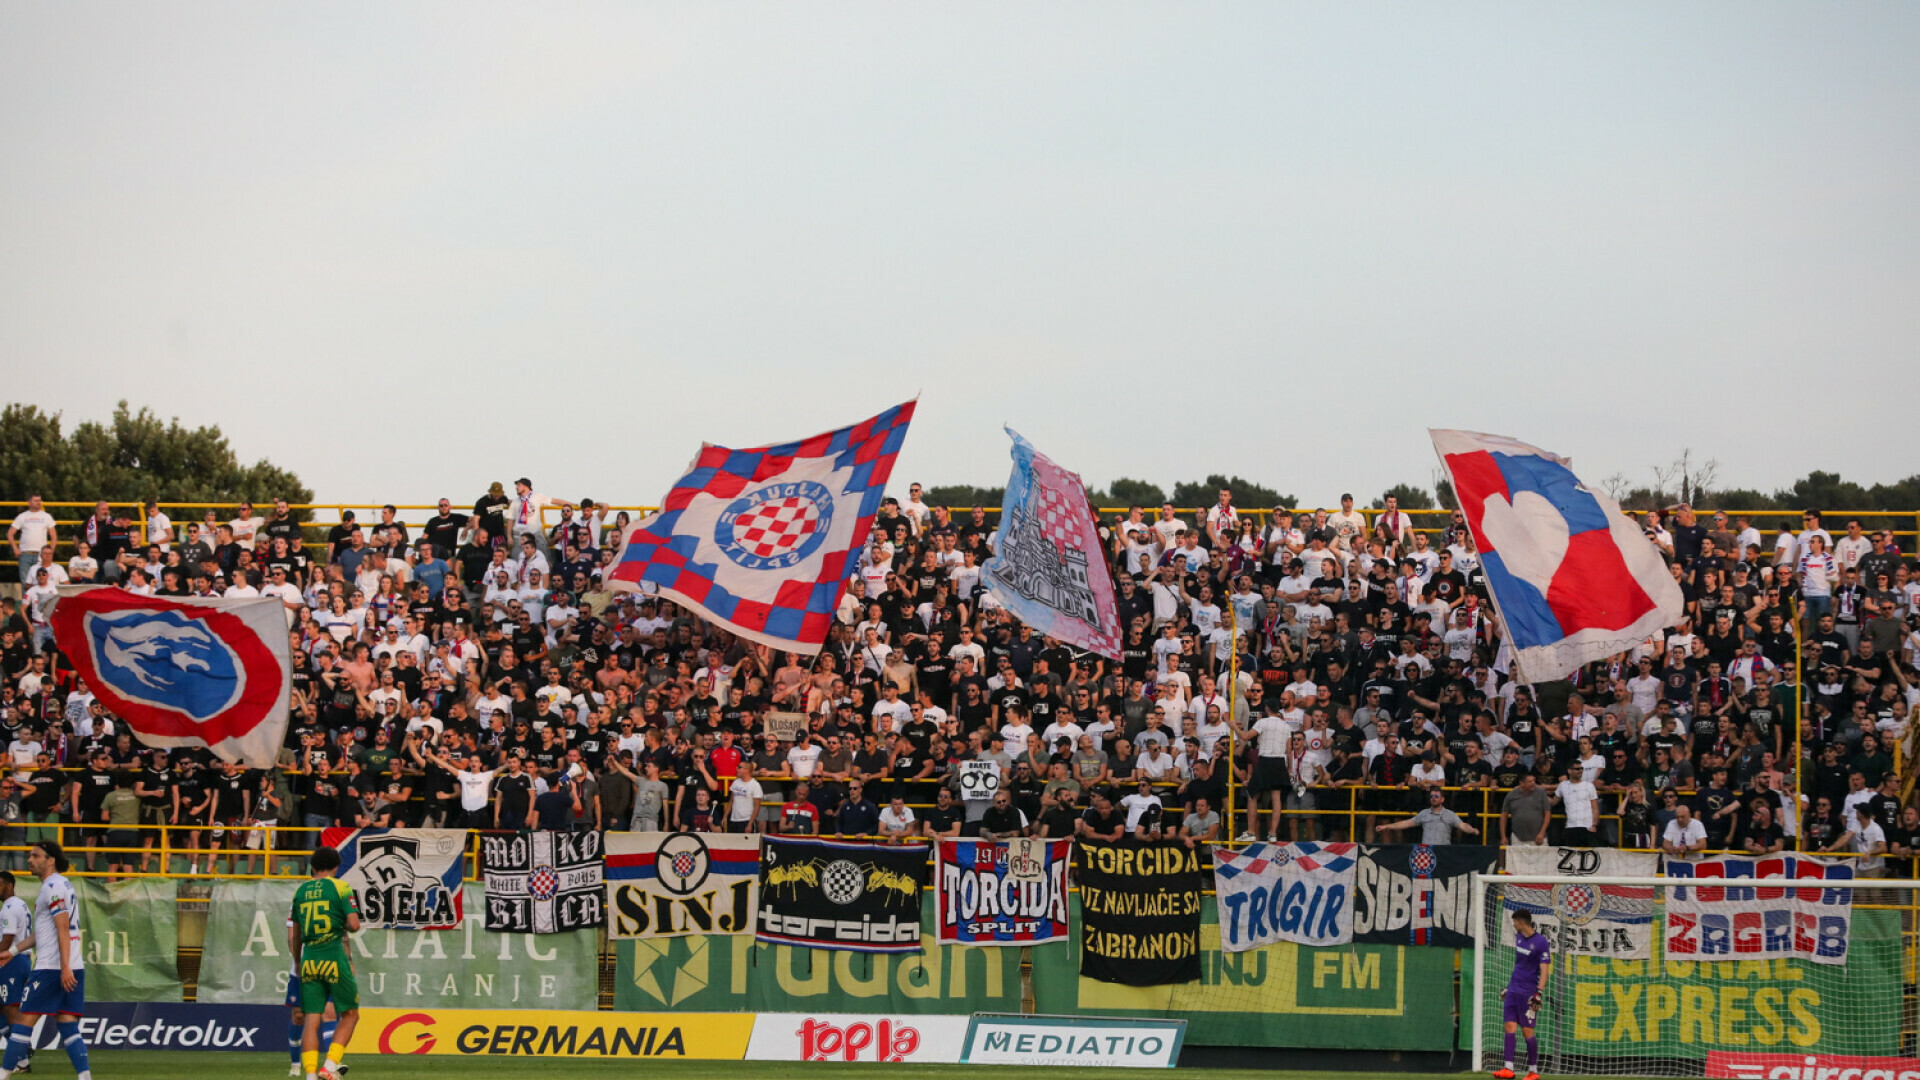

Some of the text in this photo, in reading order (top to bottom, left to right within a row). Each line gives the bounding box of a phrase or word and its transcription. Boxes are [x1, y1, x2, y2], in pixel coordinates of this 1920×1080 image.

[1080, 842, 1199, 876] TORCIDA
[1557, 847, 1601, 875] ZD
[943, 859, 1066, 925] TORCIDA
[1666, 857, 1853, 906] TORCIDA
[299, 900, 332, 936] 75
[616, 880, 752, 936] SINJ
[1081, 885, 1200, 917] UZ NAVIJAČE SA
[758, 904, 920, 942] torcida
[967, 920, 1041, 934] SPLIT
[1668, 910, 1848, 957] ZAGREB
[1085, 924, 1196, 960] ZABRANOM
[240, 970, 557, 1002] OSURANJE
[302, 960, 338, 978] AVIA
[1313, 952, 1381, 989] FM
[1574, 982, 1822, 1046] EXPRESS
[78, 1018, 260, 1048] Electrolux
[456, 1025, 686, 1056] GERMANIA
[983, 1031, 1163, 1056] MEDIATIO
